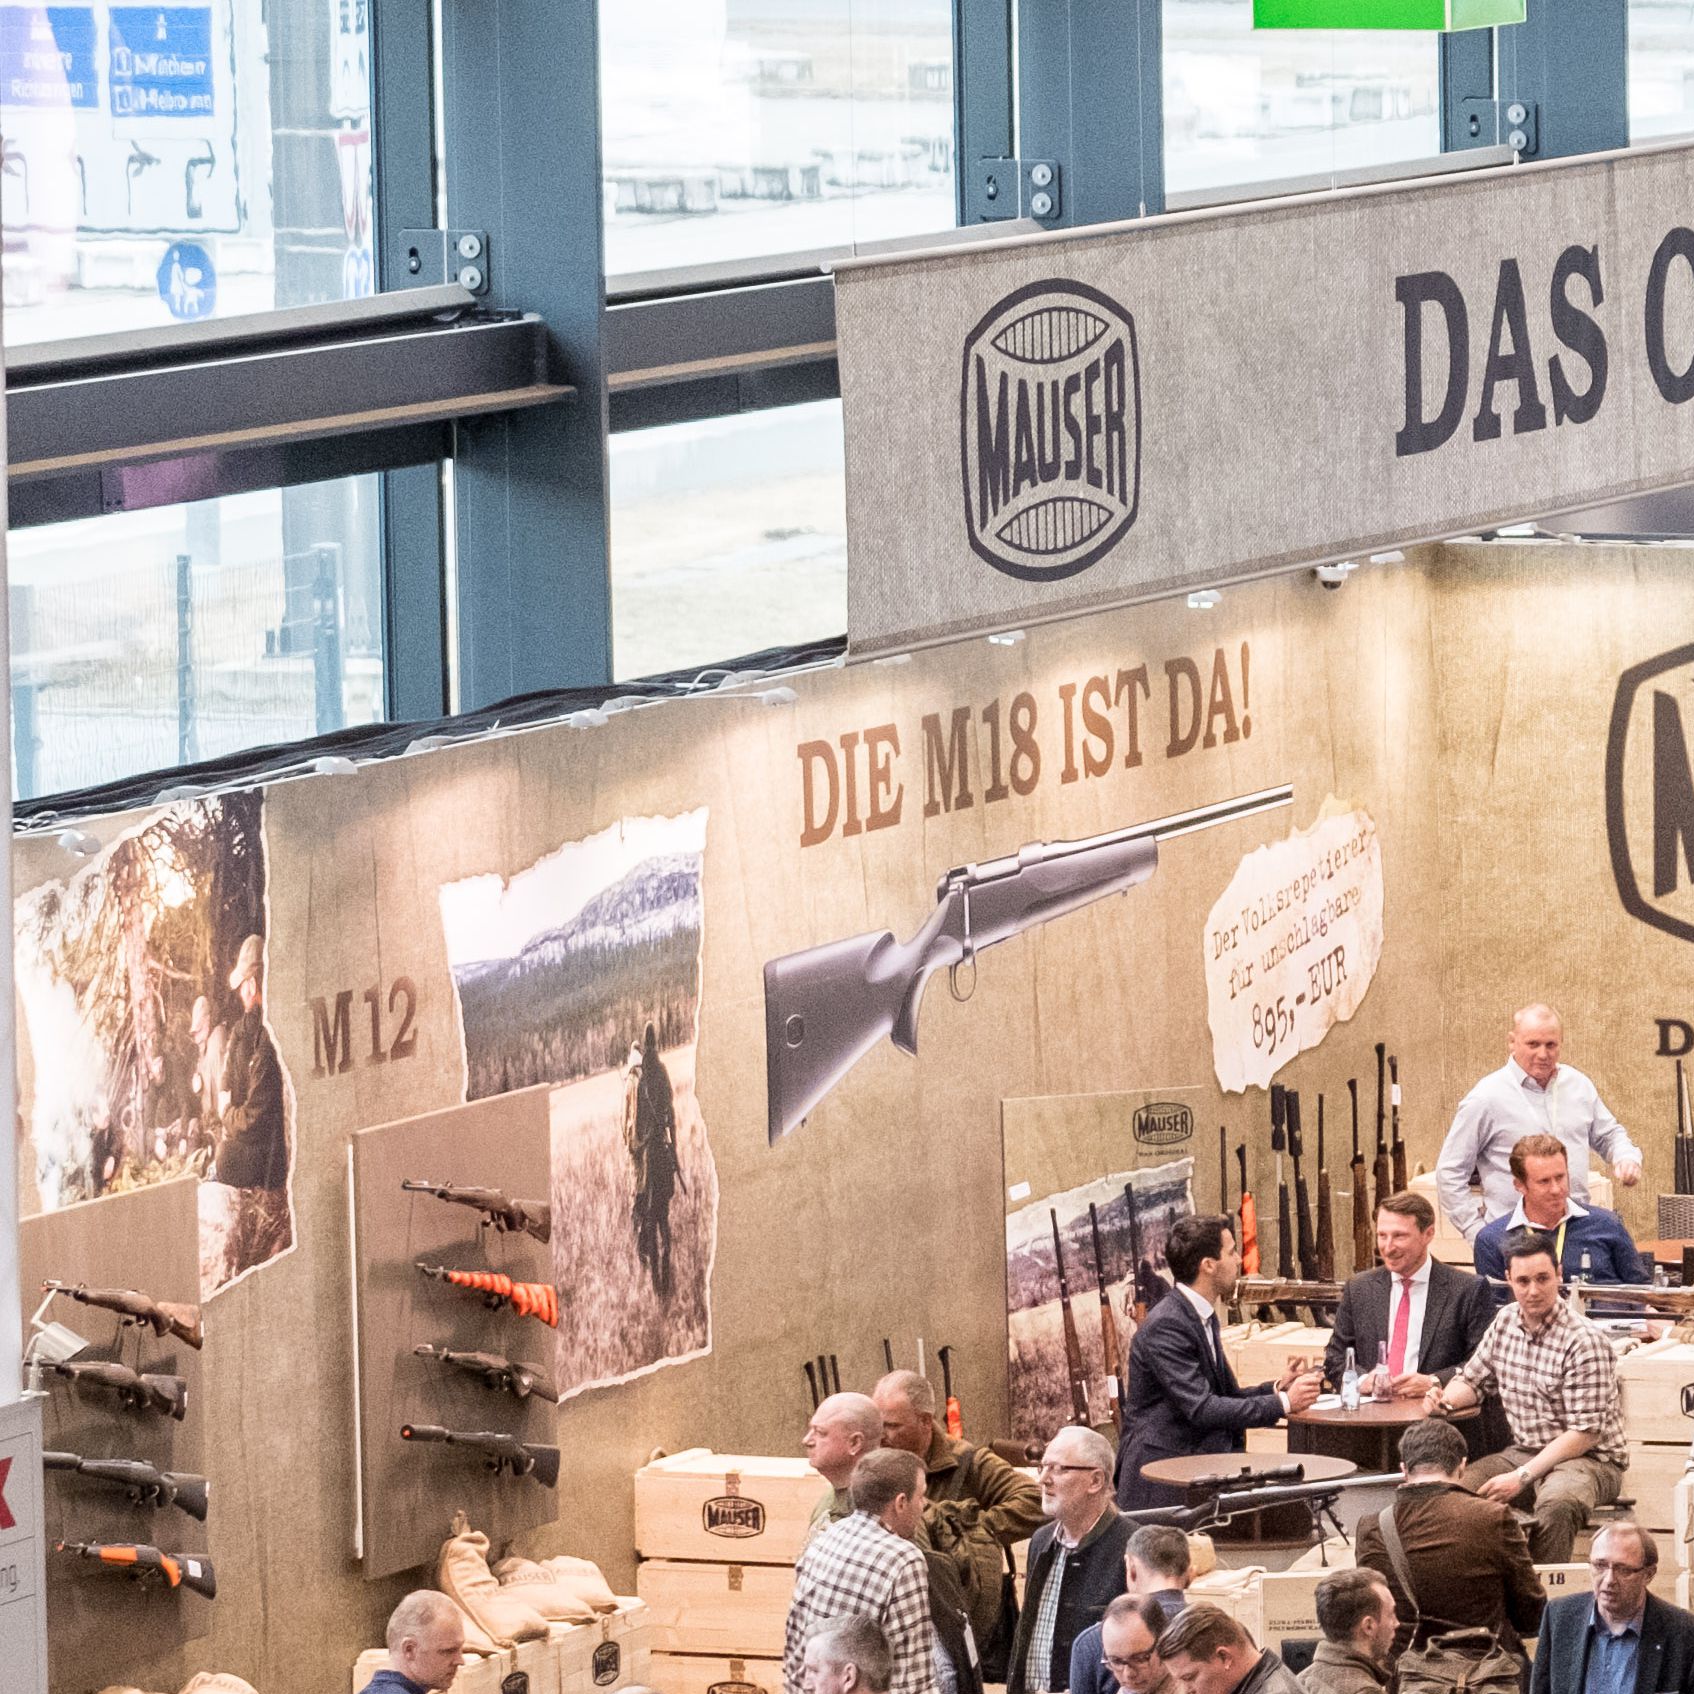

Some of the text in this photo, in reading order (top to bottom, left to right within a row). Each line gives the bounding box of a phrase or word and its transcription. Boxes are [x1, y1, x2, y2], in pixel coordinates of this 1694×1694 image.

[1396, 243, 1609, 457] DAS
[976, 337, 1127, 533] MAUSER
[797, 642, 1252, 848] DIE M18 IST DA!
[1213, 829, 1367, 960] Der Volksrepetierer
[1229, 885, 1361, 1000] für unschlagbare
[1138, 1110, 1189, 1138] MAUSER
[707, 1504, 761, 1528] MAUSER
